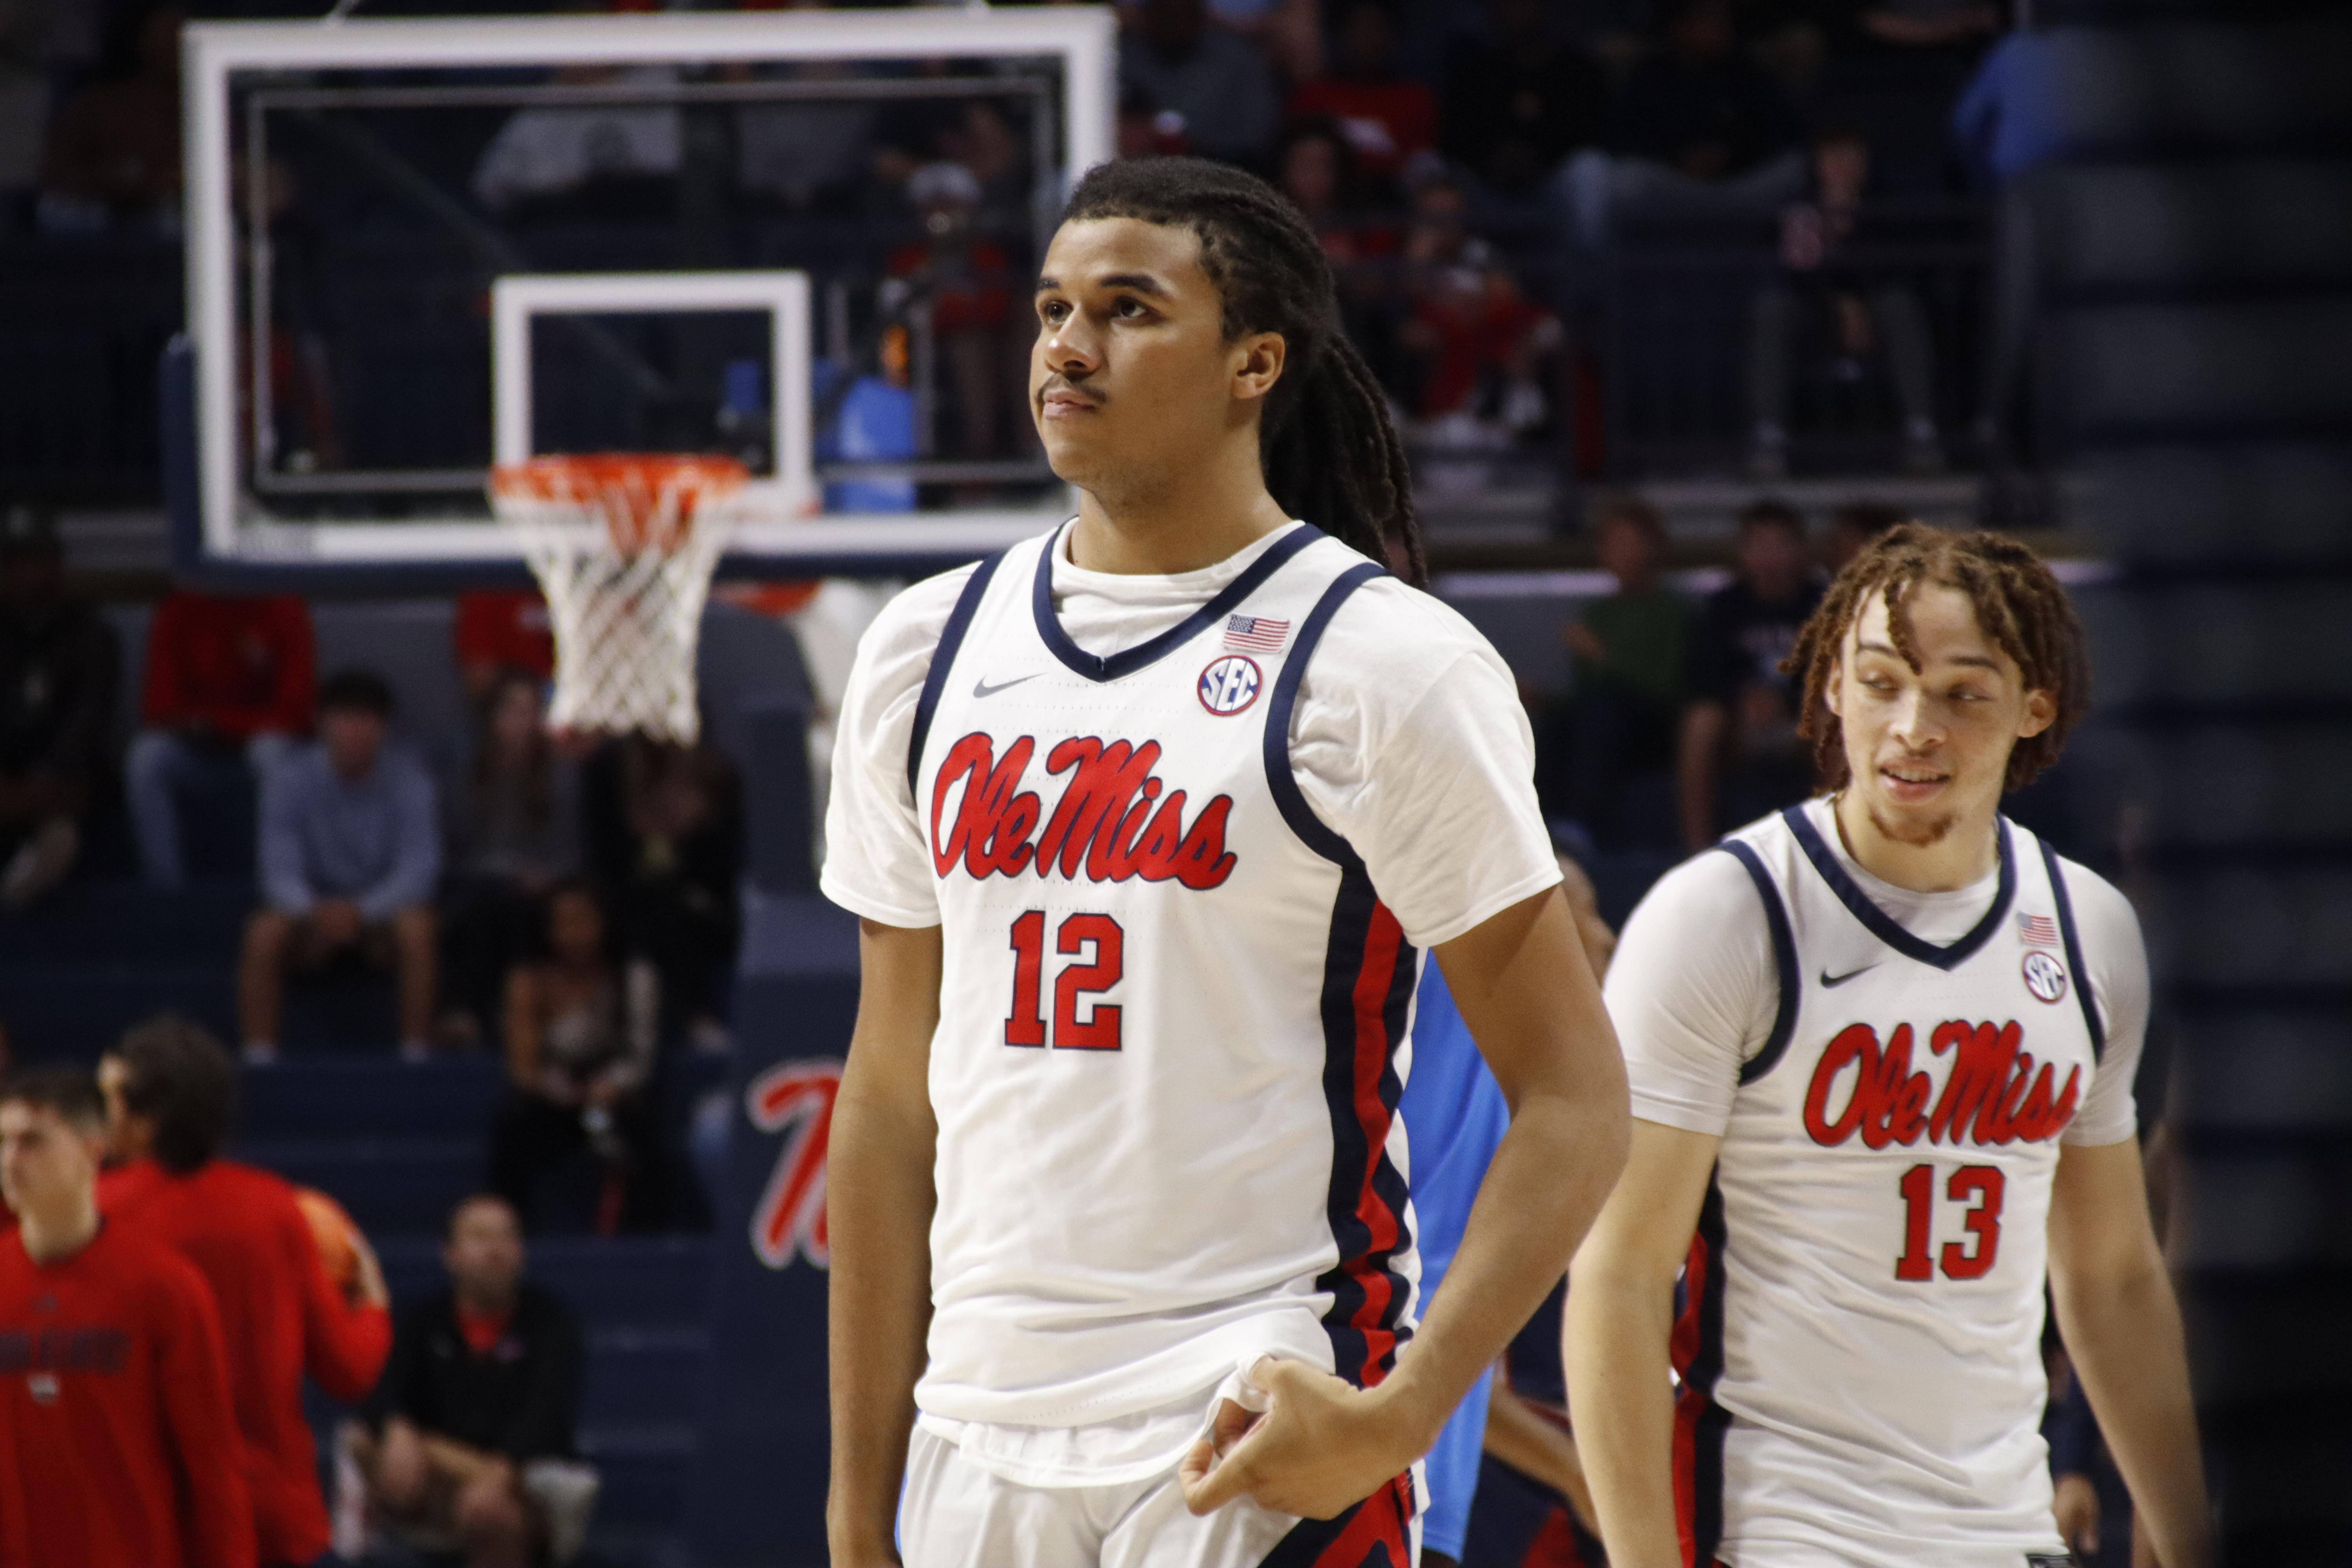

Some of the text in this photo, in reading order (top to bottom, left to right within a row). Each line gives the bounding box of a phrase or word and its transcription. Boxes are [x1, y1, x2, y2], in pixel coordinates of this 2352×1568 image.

[1201, 658, 1258, 712] SEC
[931, 732, 1237, 890] Ole Miss
[1005, 910, 1124, 1051] 12
[1804, 1020, 2080, 1149] Ole Miss
[1895, 1164, 2005, 1281] 13
